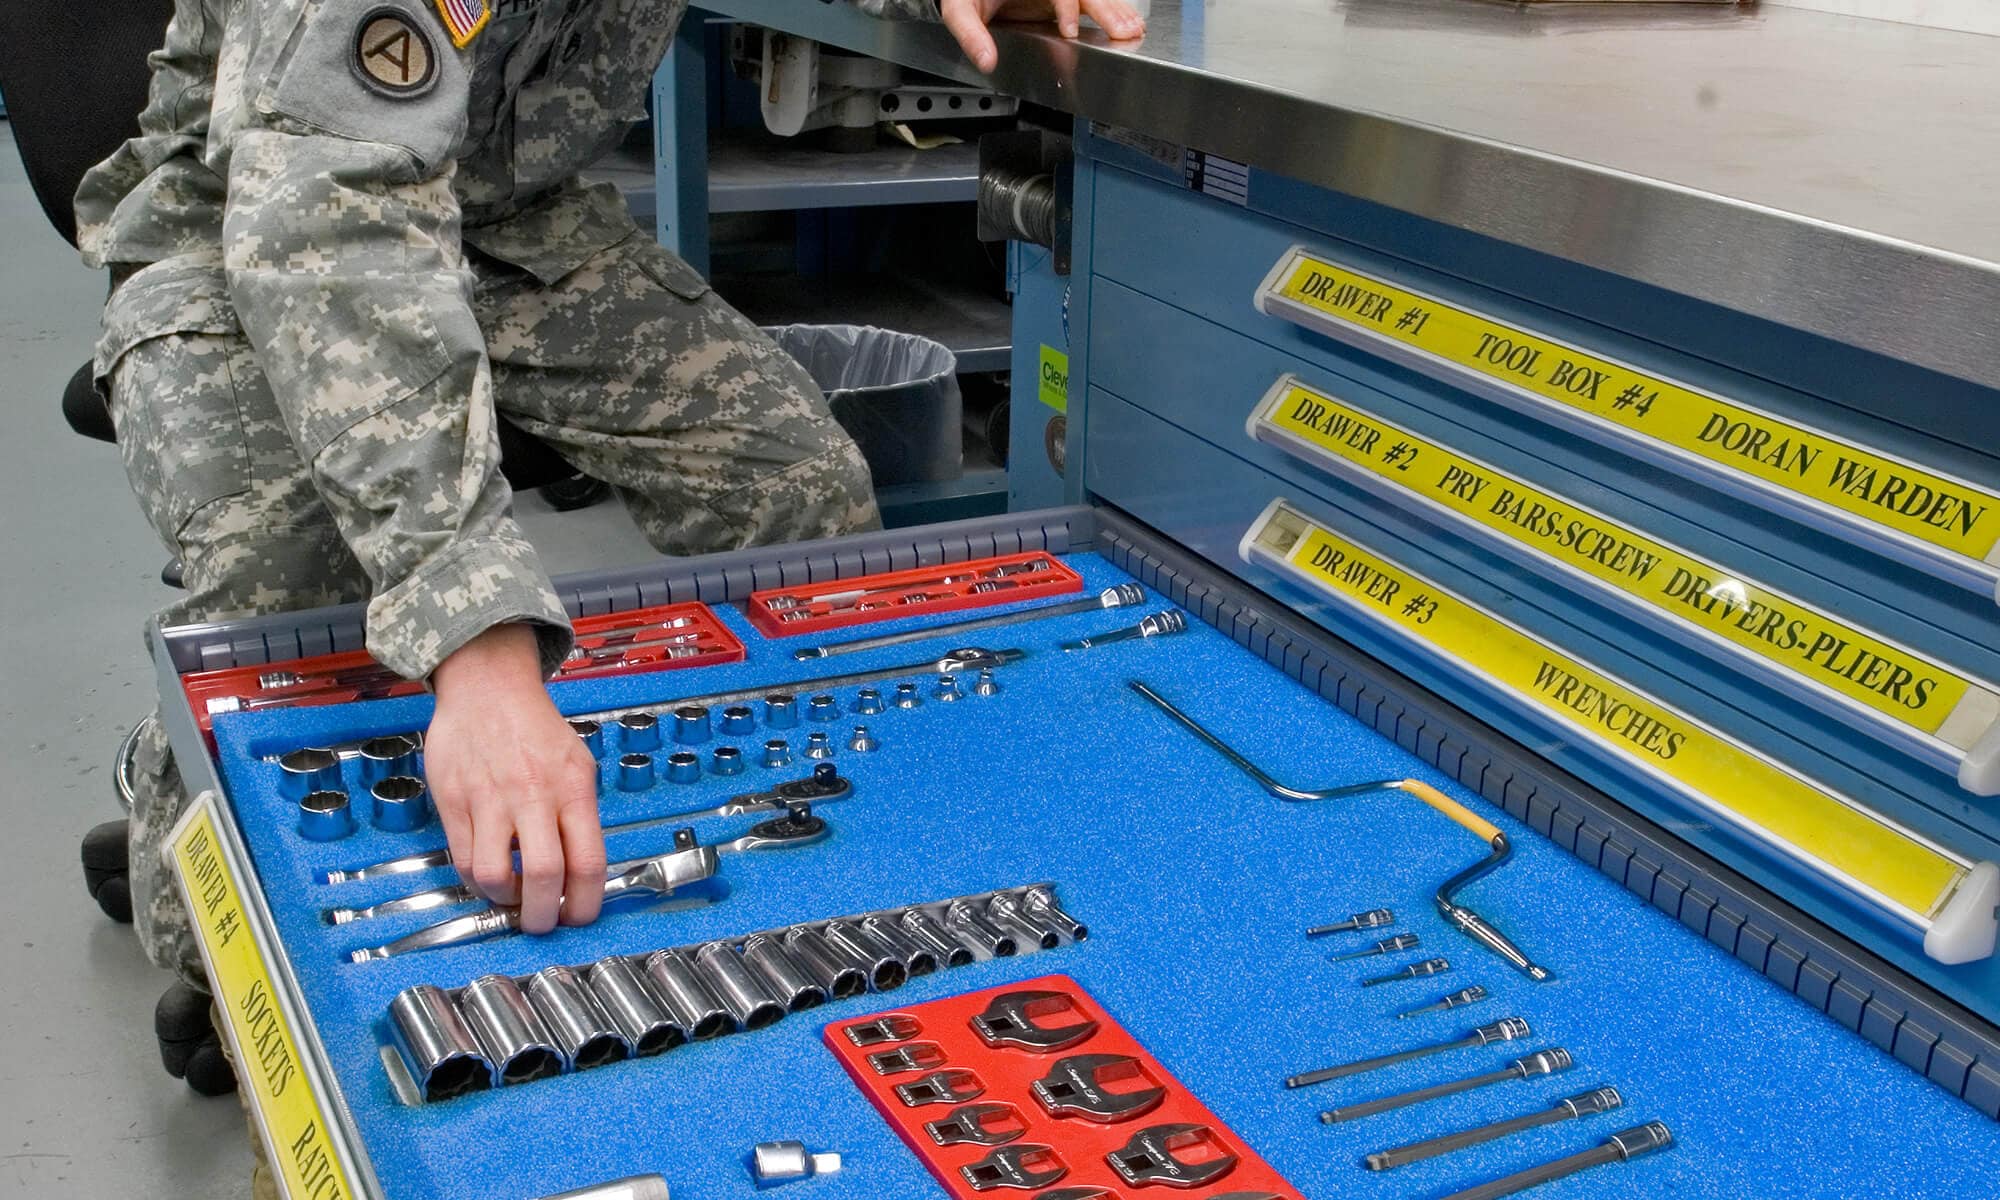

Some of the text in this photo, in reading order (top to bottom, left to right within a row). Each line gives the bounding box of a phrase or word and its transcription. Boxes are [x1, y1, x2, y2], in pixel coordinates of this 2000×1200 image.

[1300, 271, 1988, 537] DRAWER #1 TOOL BOX #4 DORAN WARDEN
[1291, 398, 1938, 709] DRAWER #2 PRY BARS-SCREW DRIVERS-PLIERS
[1310, 543, 1687, 760] DRAWER #3 WRENCHES
[186, 826, 343, 1200] DRAWER #4 SOCKETS RATC
